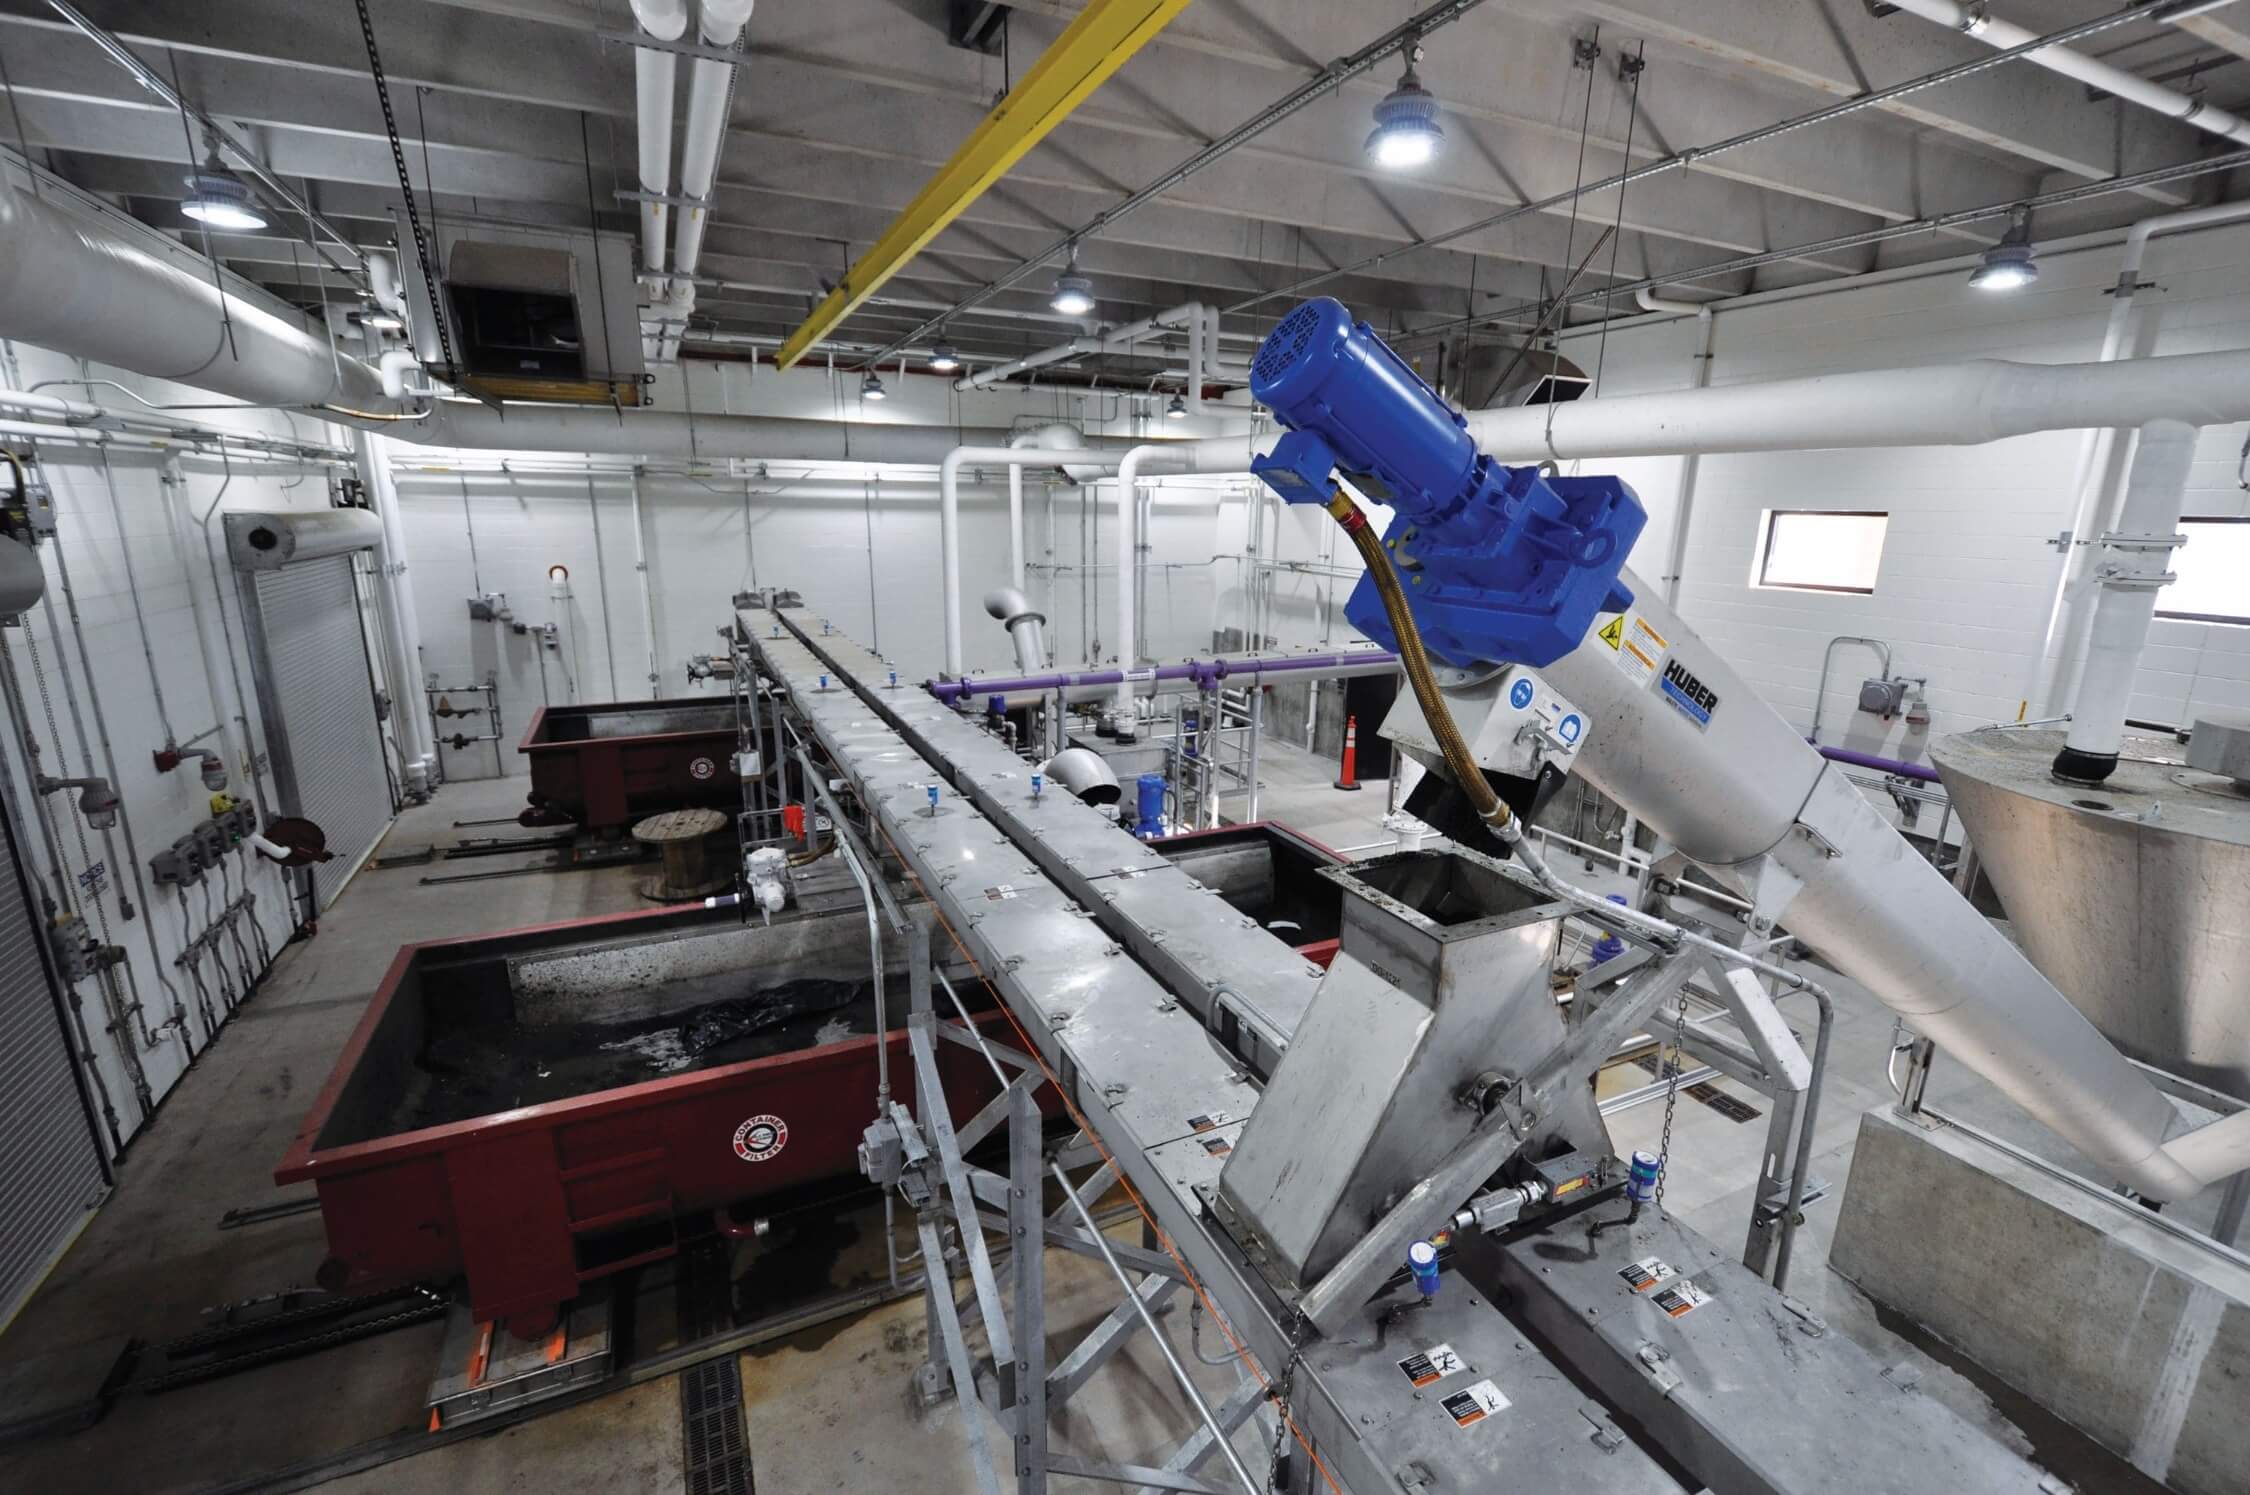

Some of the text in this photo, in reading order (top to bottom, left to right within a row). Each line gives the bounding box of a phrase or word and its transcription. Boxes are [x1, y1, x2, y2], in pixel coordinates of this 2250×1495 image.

[1664, 659, 1718, 714] HUBER
[736, 1116, 784, 1141] CONTAINER
[744, 1145, 780, 1160] FILTER
